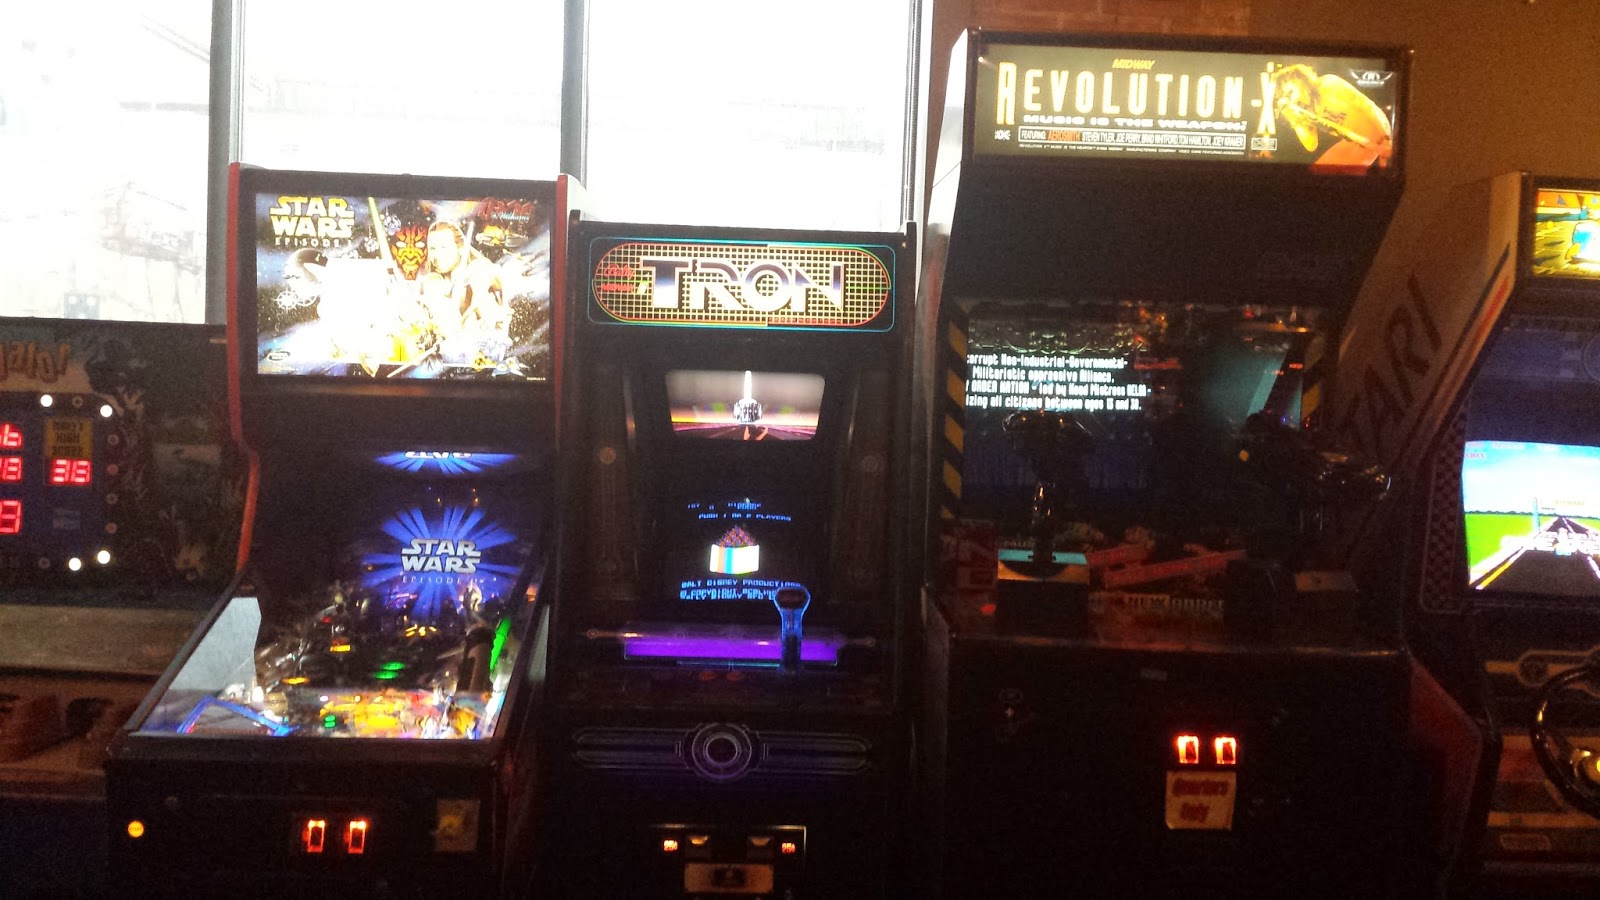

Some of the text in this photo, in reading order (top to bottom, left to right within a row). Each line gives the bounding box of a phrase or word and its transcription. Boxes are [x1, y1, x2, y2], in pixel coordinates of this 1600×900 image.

[1112, 58, 1156, 70] MIDWAY
[1023, 114, 1085, 125] MUSIC
[1090, 116, 1109, 126] IS
[1114, 117, 1153, 127] THE
[269, 195, 355, 219] STAR
[269, 216, 355, 239] WARS
[275, 237, 344, 248] EPISODE
[641, 258, 845, 313] TRON
[972, 365, 1026, 380] Militaristic
[971, 379, 998, 393] ORDER
[1000, 380, 1030, 394] NATION
[1039, 382, 1054, 395] led
[1055, 382, 1067, 397] by
[990, 394, 1003, 408] all
[1005, 395, 1043, 409] citizens
[1044, 396, 1083, 410] between
[1084, 398, 1104, 412] ages
[1115, 398, 1129, 410] and
[401, 538, 482, 556] STAR
[401, 556, 481, 574] WARS
[706, 579, 738, 587] DISNEY
